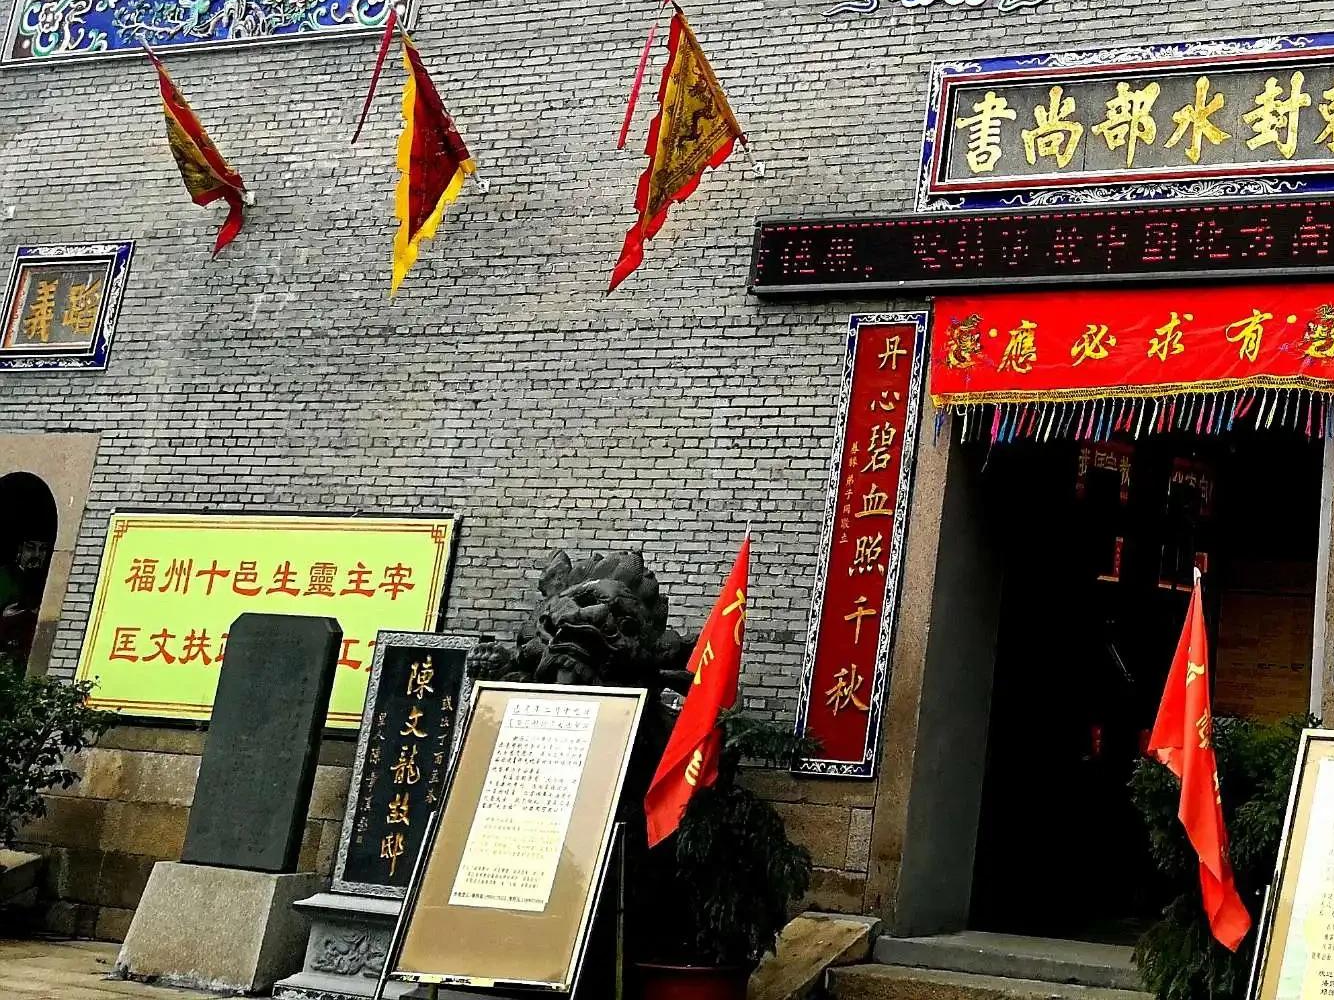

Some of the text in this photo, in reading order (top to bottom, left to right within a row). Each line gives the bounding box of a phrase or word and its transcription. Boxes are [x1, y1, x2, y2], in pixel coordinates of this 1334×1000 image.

[124, 558, 416, 601] 福州十邑生靈主宰
[824, 335, 908, 718] 丹心碧血照千秋
